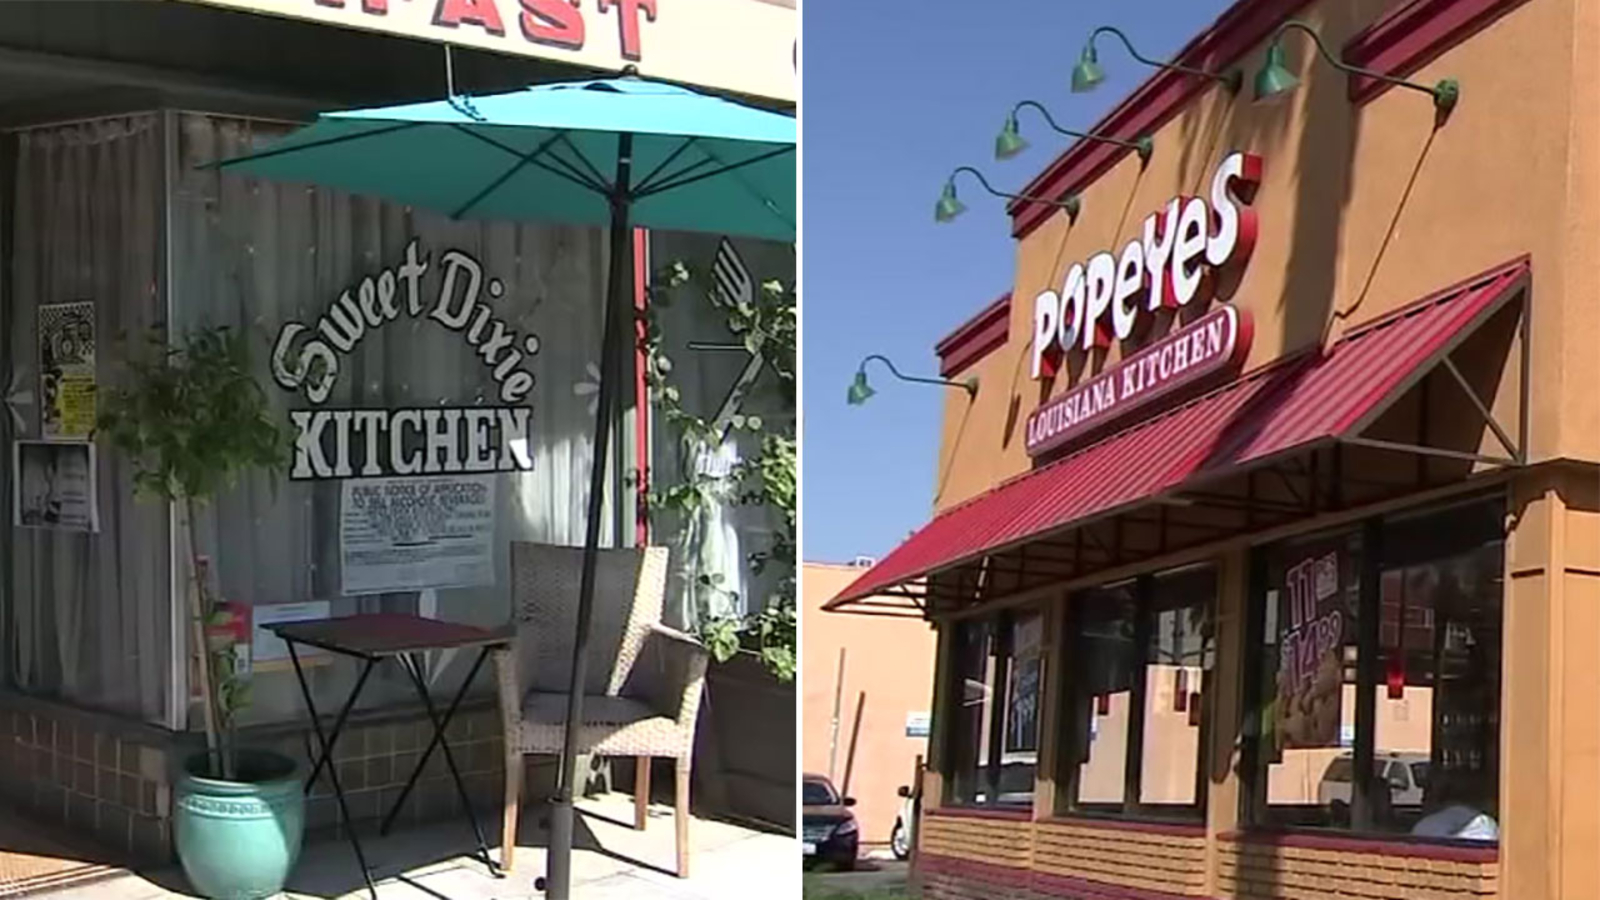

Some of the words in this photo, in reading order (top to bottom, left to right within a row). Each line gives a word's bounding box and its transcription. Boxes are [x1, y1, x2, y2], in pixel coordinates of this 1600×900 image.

[272, 237, 430, 403] Sweet
[428, 248, 540, 403] Dixie
[1027, 382, 1117, 448] LOUISIANA
[1120, 316, 1226, 401] KITCHEN
[289, 406, 534, 481] KITCHEN
